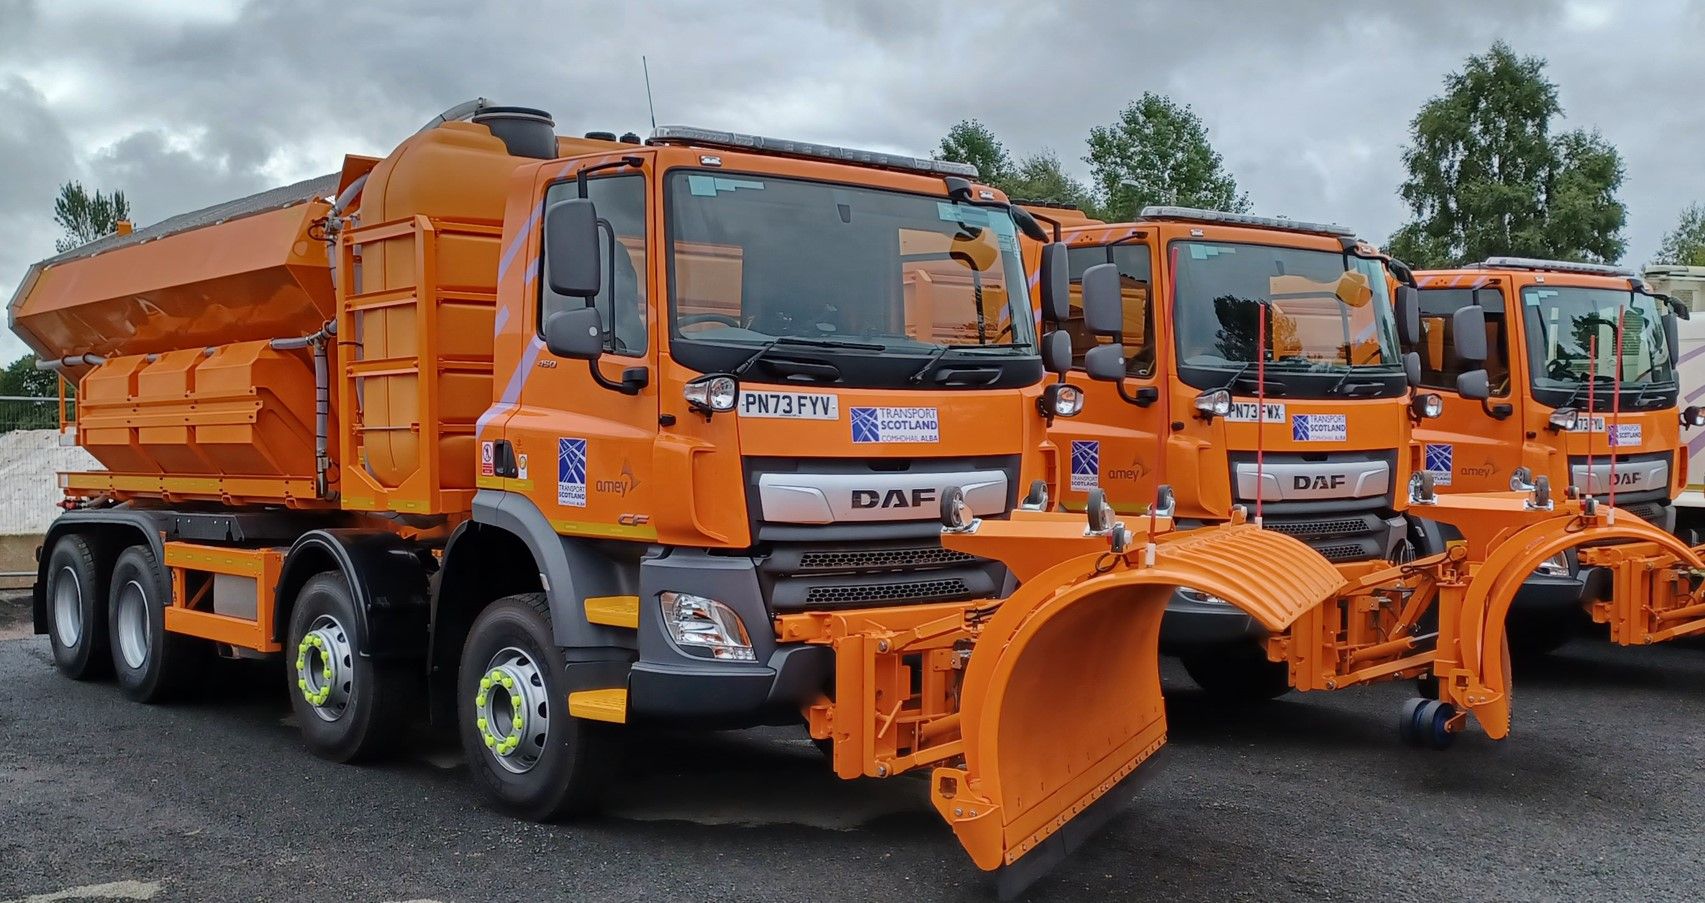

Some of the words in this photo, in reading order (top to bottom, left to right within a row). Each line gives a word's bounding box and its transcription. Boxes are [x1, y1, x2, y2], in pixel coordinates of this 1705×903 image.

[536, 360, 557, 368] 450
[745, 393, 793, 414] PN73
[797, 395, 830, 415] FYV
[880, 408, 936, 419] TRANSPORT
[1229, 403, 1258, 418] PN73
[881, 420, 938, 430] SCOTLAND
[1310, 415, 1345, 424] TRANSPORT
[1310, 424, 1346, 432] SCOTLAND
[1108, 469, 1139, 482] amey
[1461, 467, 1489, 478] amey
[1609, 472, 1642, 485] DAF
[1293, 474, 1346, 490] DAF
[559, 484, 585, 493] TRANSPORT
[595, 480, 628, 498] amey
[559, 491, 586, 500] SCOTLAND
[851, 488, 936, 509] DAF
[618, 513, 650, 526] CF
